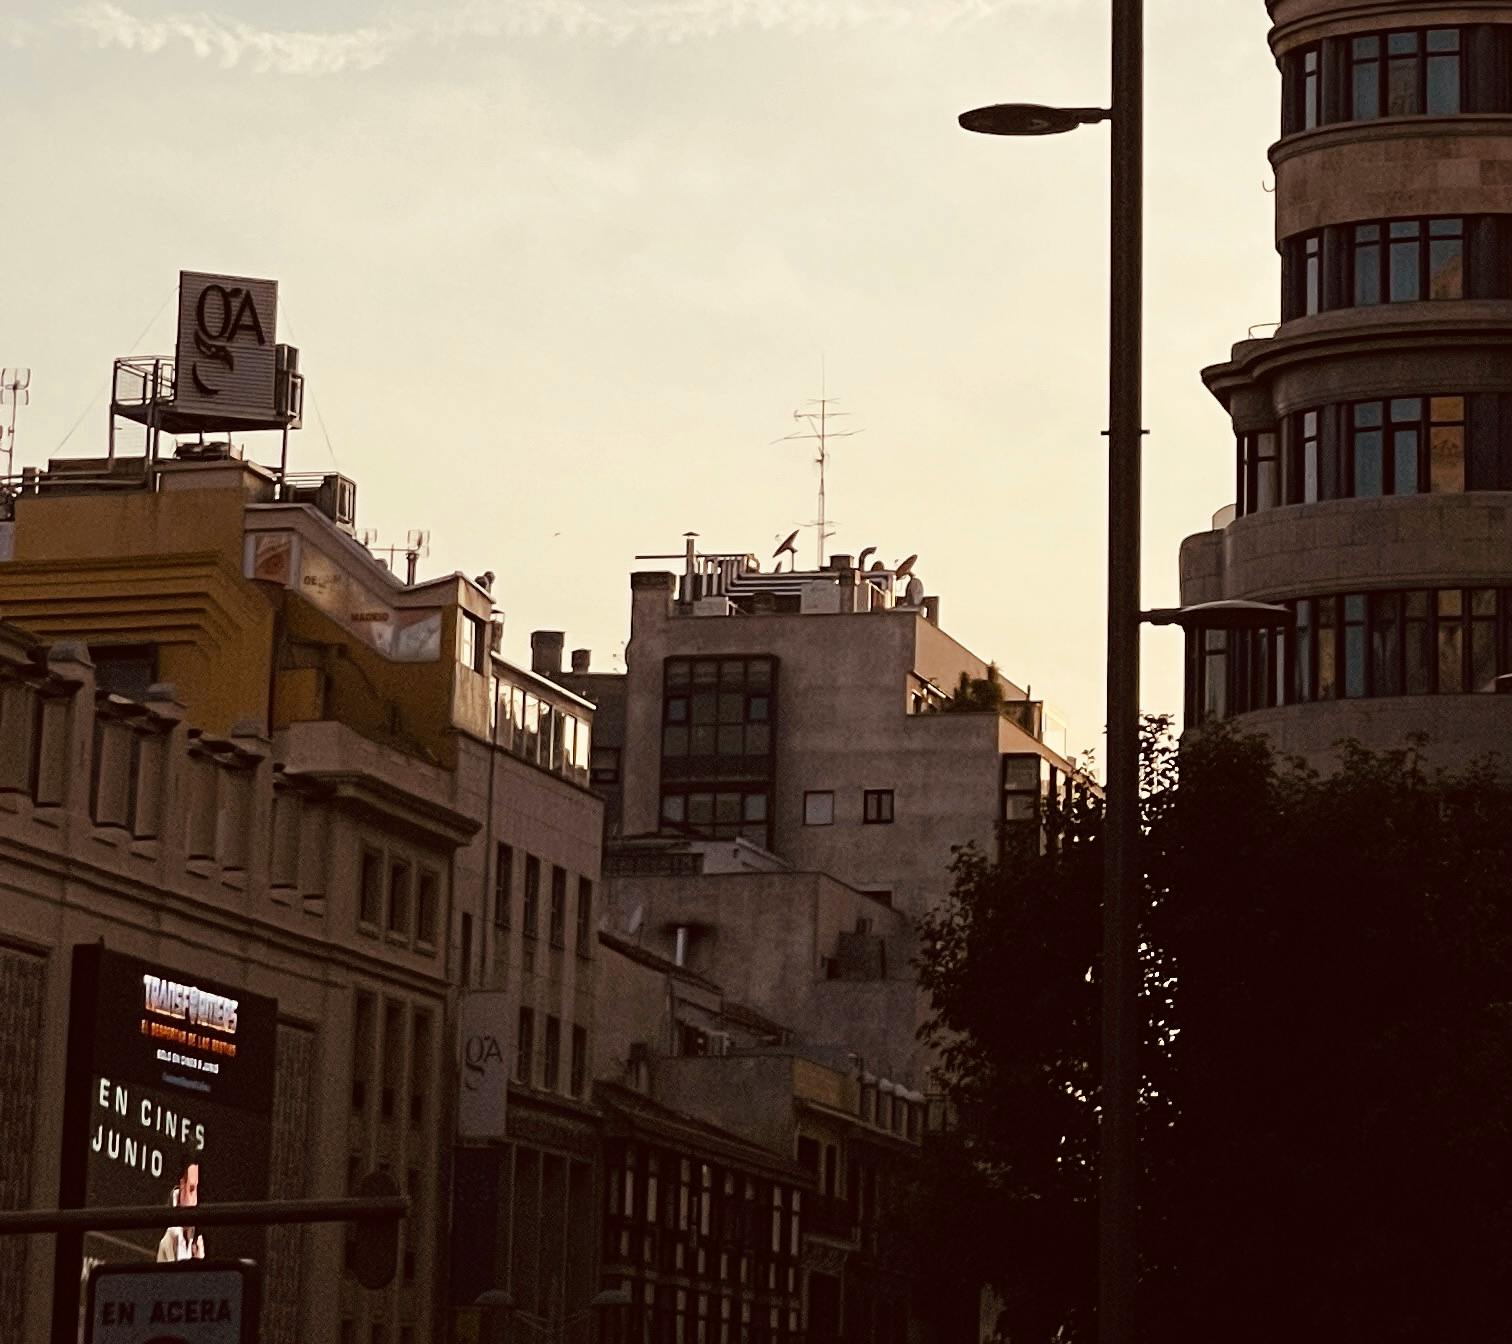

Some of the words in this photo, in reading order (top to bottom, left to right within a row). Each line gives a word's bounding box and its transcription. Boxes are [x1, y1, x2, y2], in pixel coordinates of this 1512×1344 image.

[99, 1077, 128, 1116] EN
[92, 1124, 163, 1178] JUNIO
[101, 1301, 136, 1326] EN
[150, 1298, 232, 1325] ACERA
